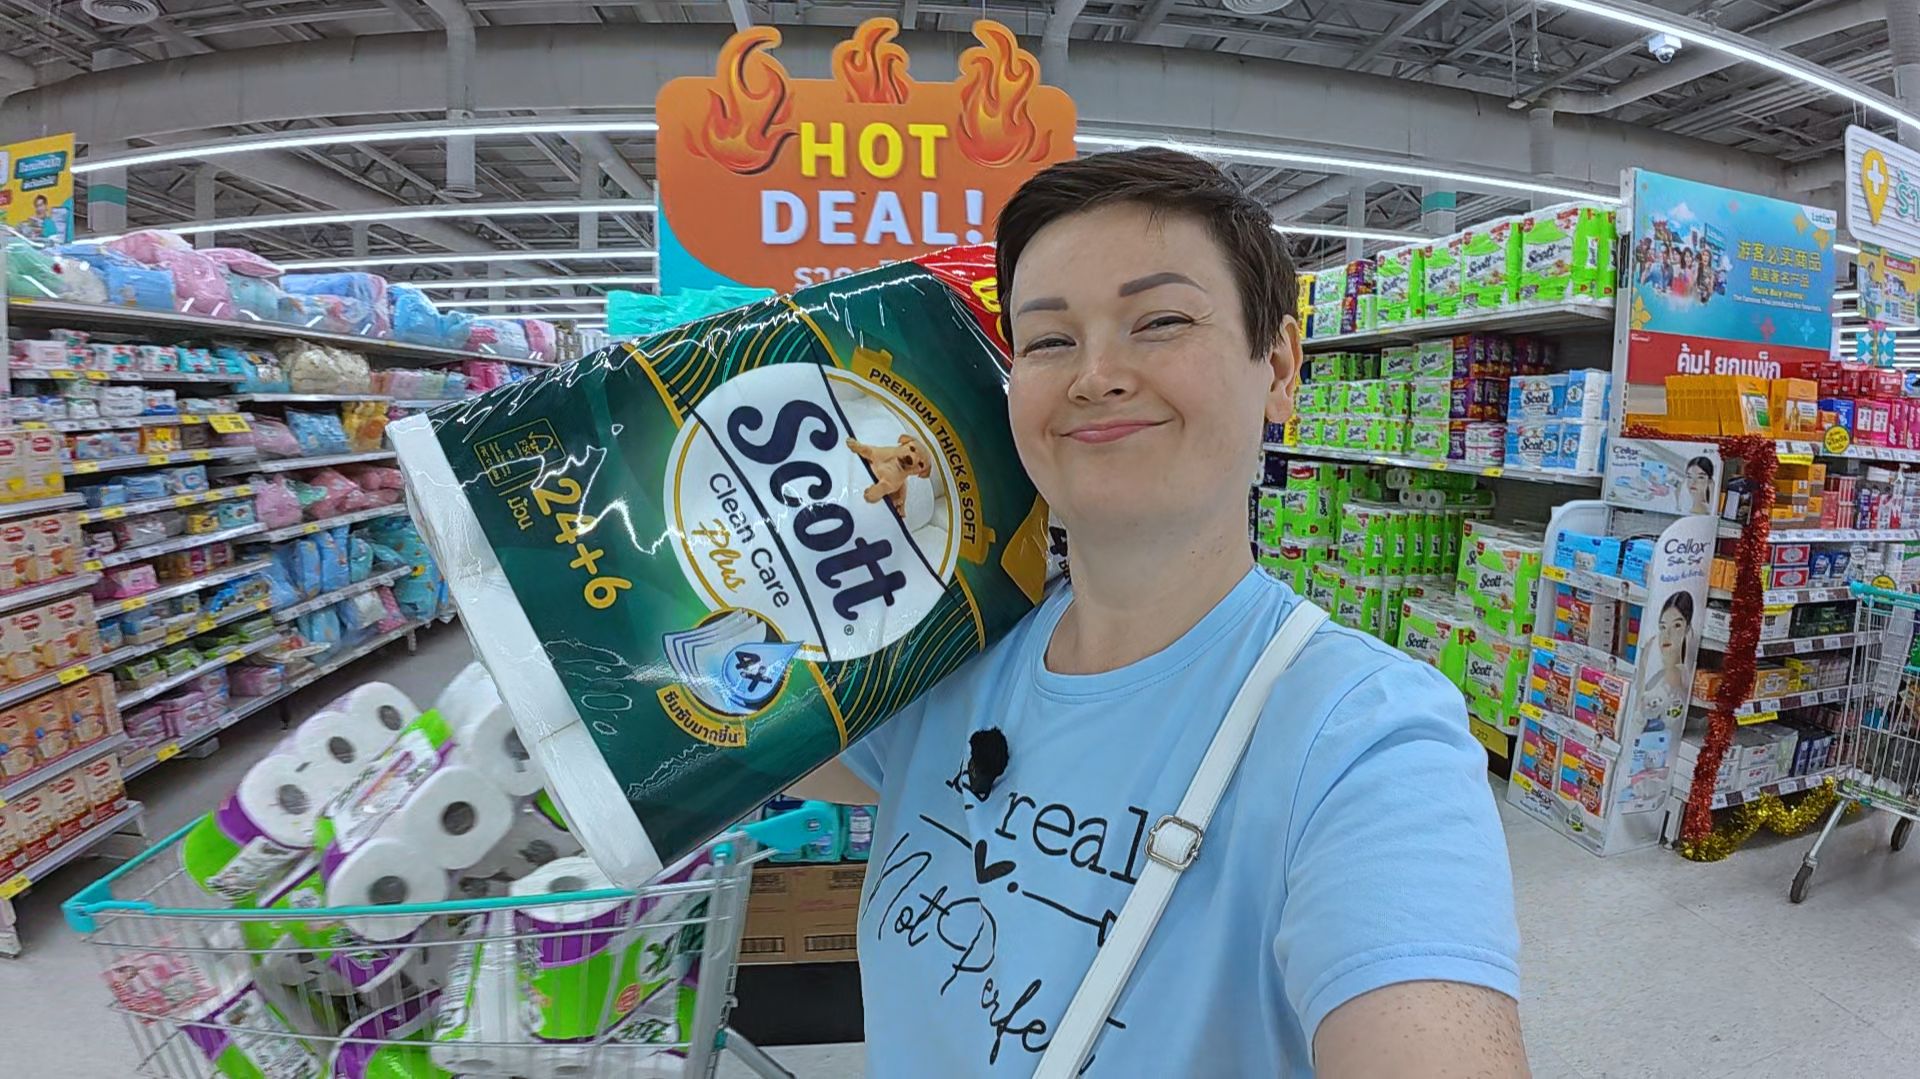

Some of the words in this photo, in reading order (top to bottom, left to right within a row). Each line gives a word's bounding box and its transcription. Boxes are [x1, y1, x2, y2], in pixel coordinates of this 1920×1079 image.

[800, 121, 948, 178] HOT
[761, 189, 984, 245] DEAL!
[1738, 241, 1821, 272] 游客必买商品
[869, 368, 937, 425] PREMIUM
[1524, 391, 1550, 405] Scott
[935, 426, 966, 479] THICK
[727, 400, 907, 621] Scott
[959, 481, 970, 492] &
[507, 496, 534, 530] ม้วน
[961, 494, 977, 544] SOFT
[532, 478, 632, 609] 24+6
[691, 518, 748, 594] Plus
[708, 473, 755, 544] Clean
[750, 547, 790, 608] Care
[1664, 538, 1708, 555] Cellox
[1480, 573, 1502, 590] Scott
[1405, 633, 1429, 650] Scott
[735, 651, 773, 692] 4X
[1469, 661, 1493, 677] Scott
[663, 690, 738, 743] ซึมซับมากขึ้น
[994, 792, 1149, 884] real
